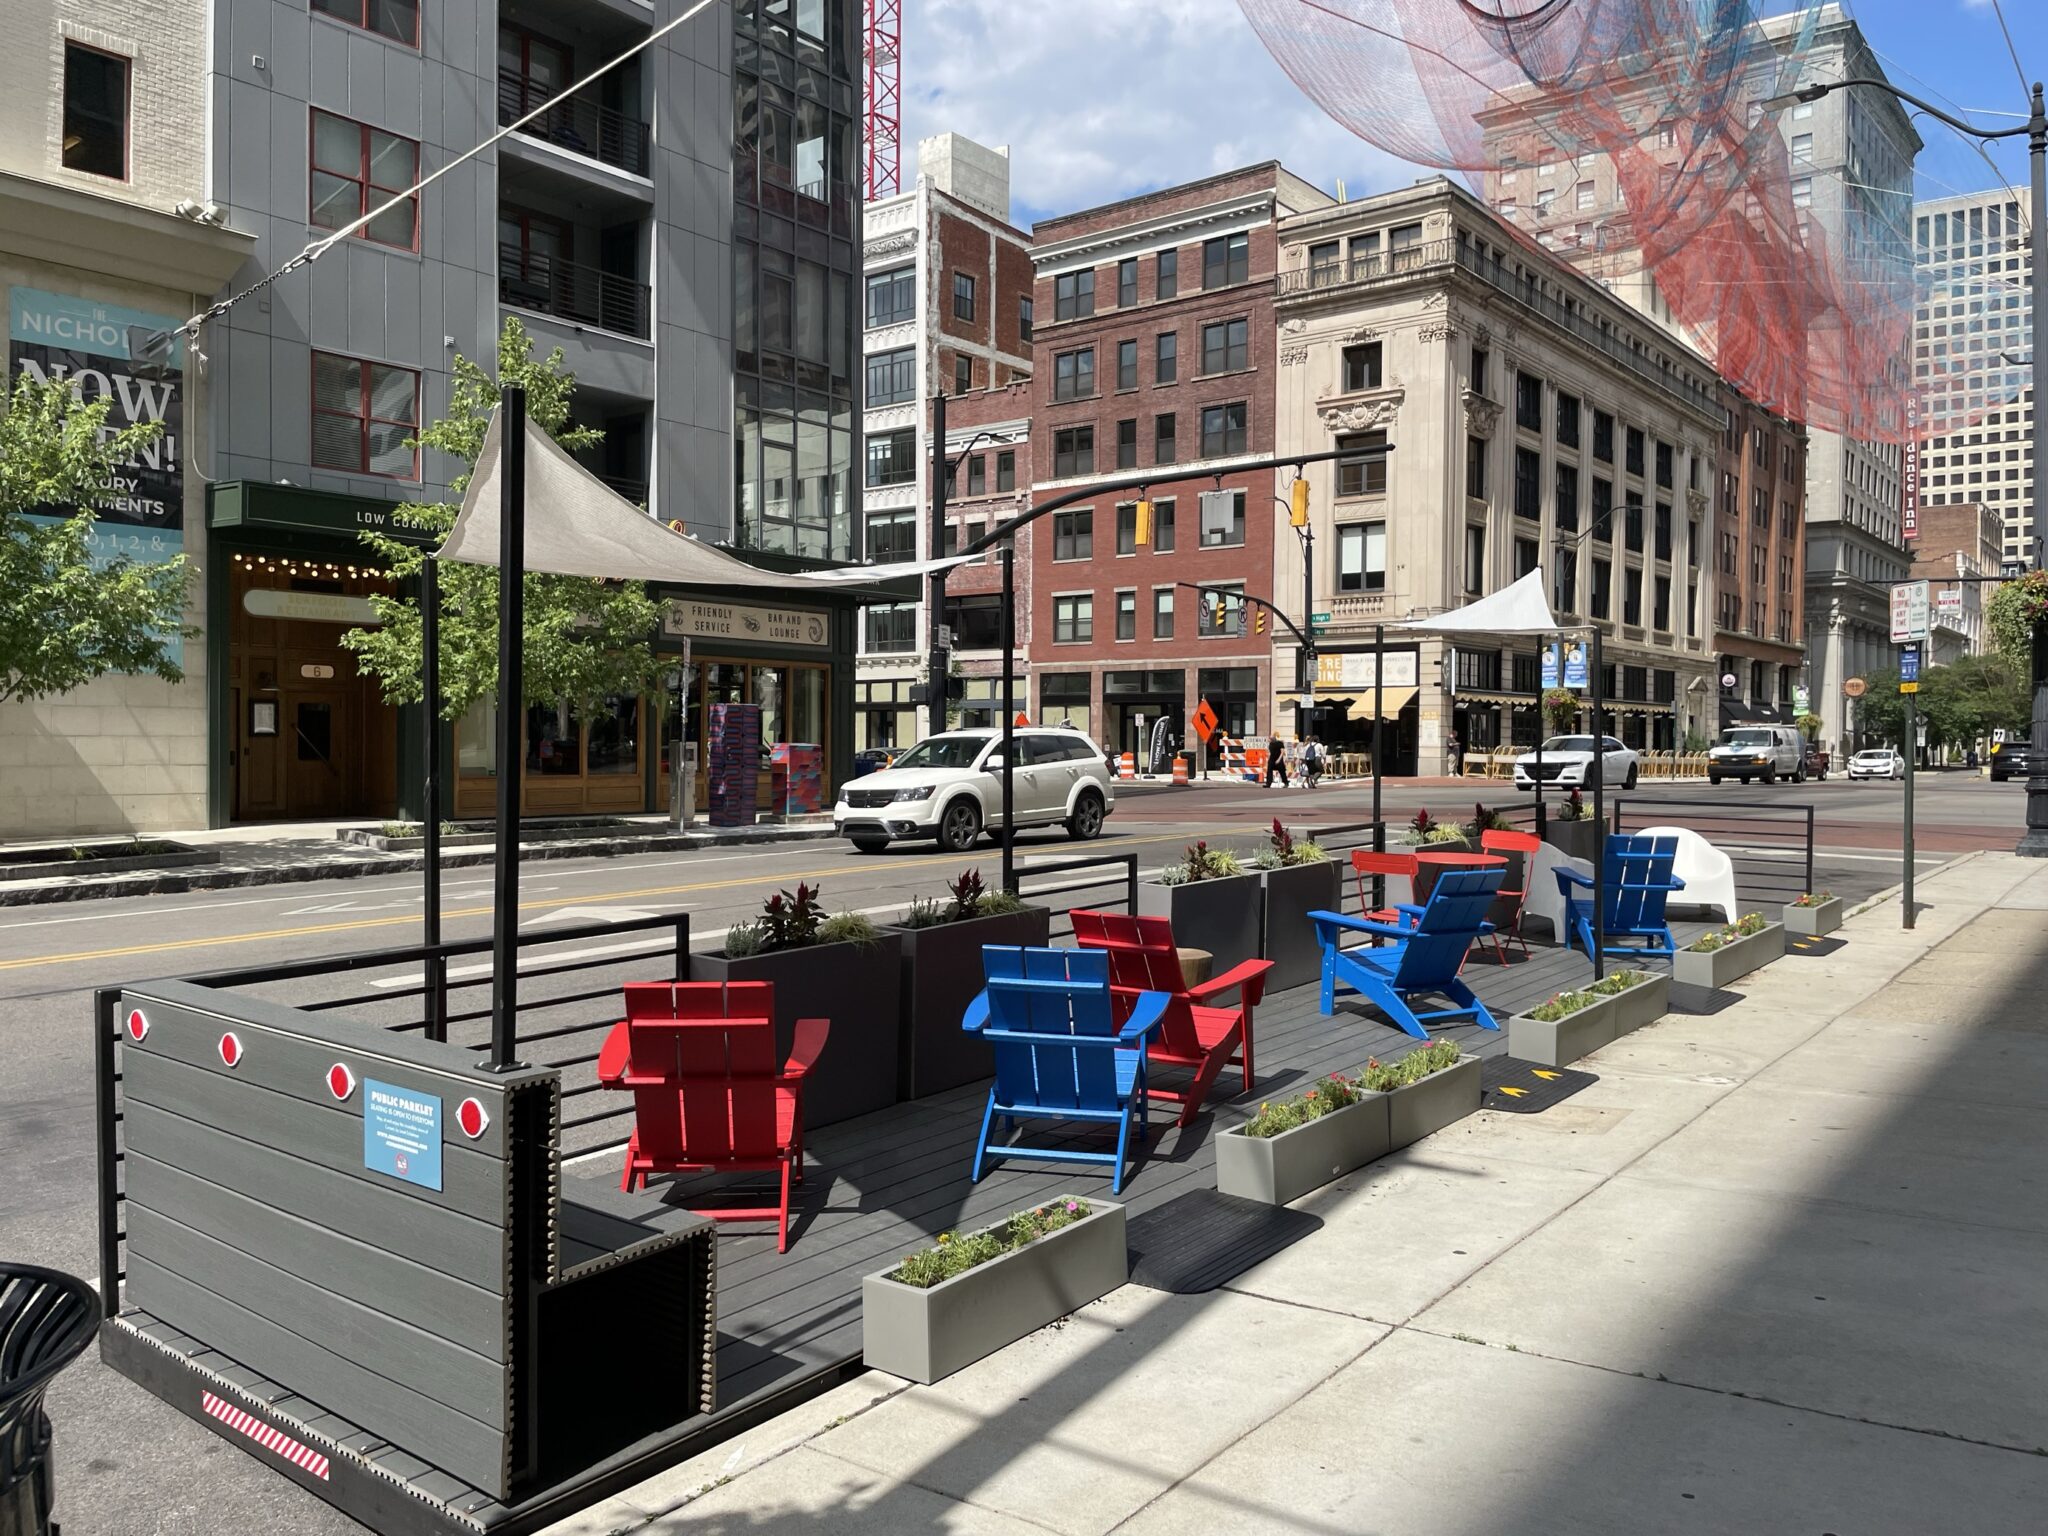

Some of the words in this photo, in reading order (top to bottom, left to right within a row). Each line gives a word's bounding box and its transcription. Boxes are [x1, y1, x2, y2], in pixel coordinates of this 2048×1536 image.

[22, 310, 131, 349] NICHOL
[1906, 398, 1917, 492] Residence
[356, 511, 385, 525] LOW
[1905, 498, 1915, 528] Inn
[691, 605, 733, 619] FRIENDLY
[694, 620, 731, 633] SERVICE
[767, 613, 783, 624] BAR
[786, 615, 801, 626] AND
[769, 628, 800, 639] LOUNGE
[1318, 657, 1341, 669] E'RE
[371, 1090, 398, 1107] PUBLIC
[399, 1098, 433, 1116] PARKLET
